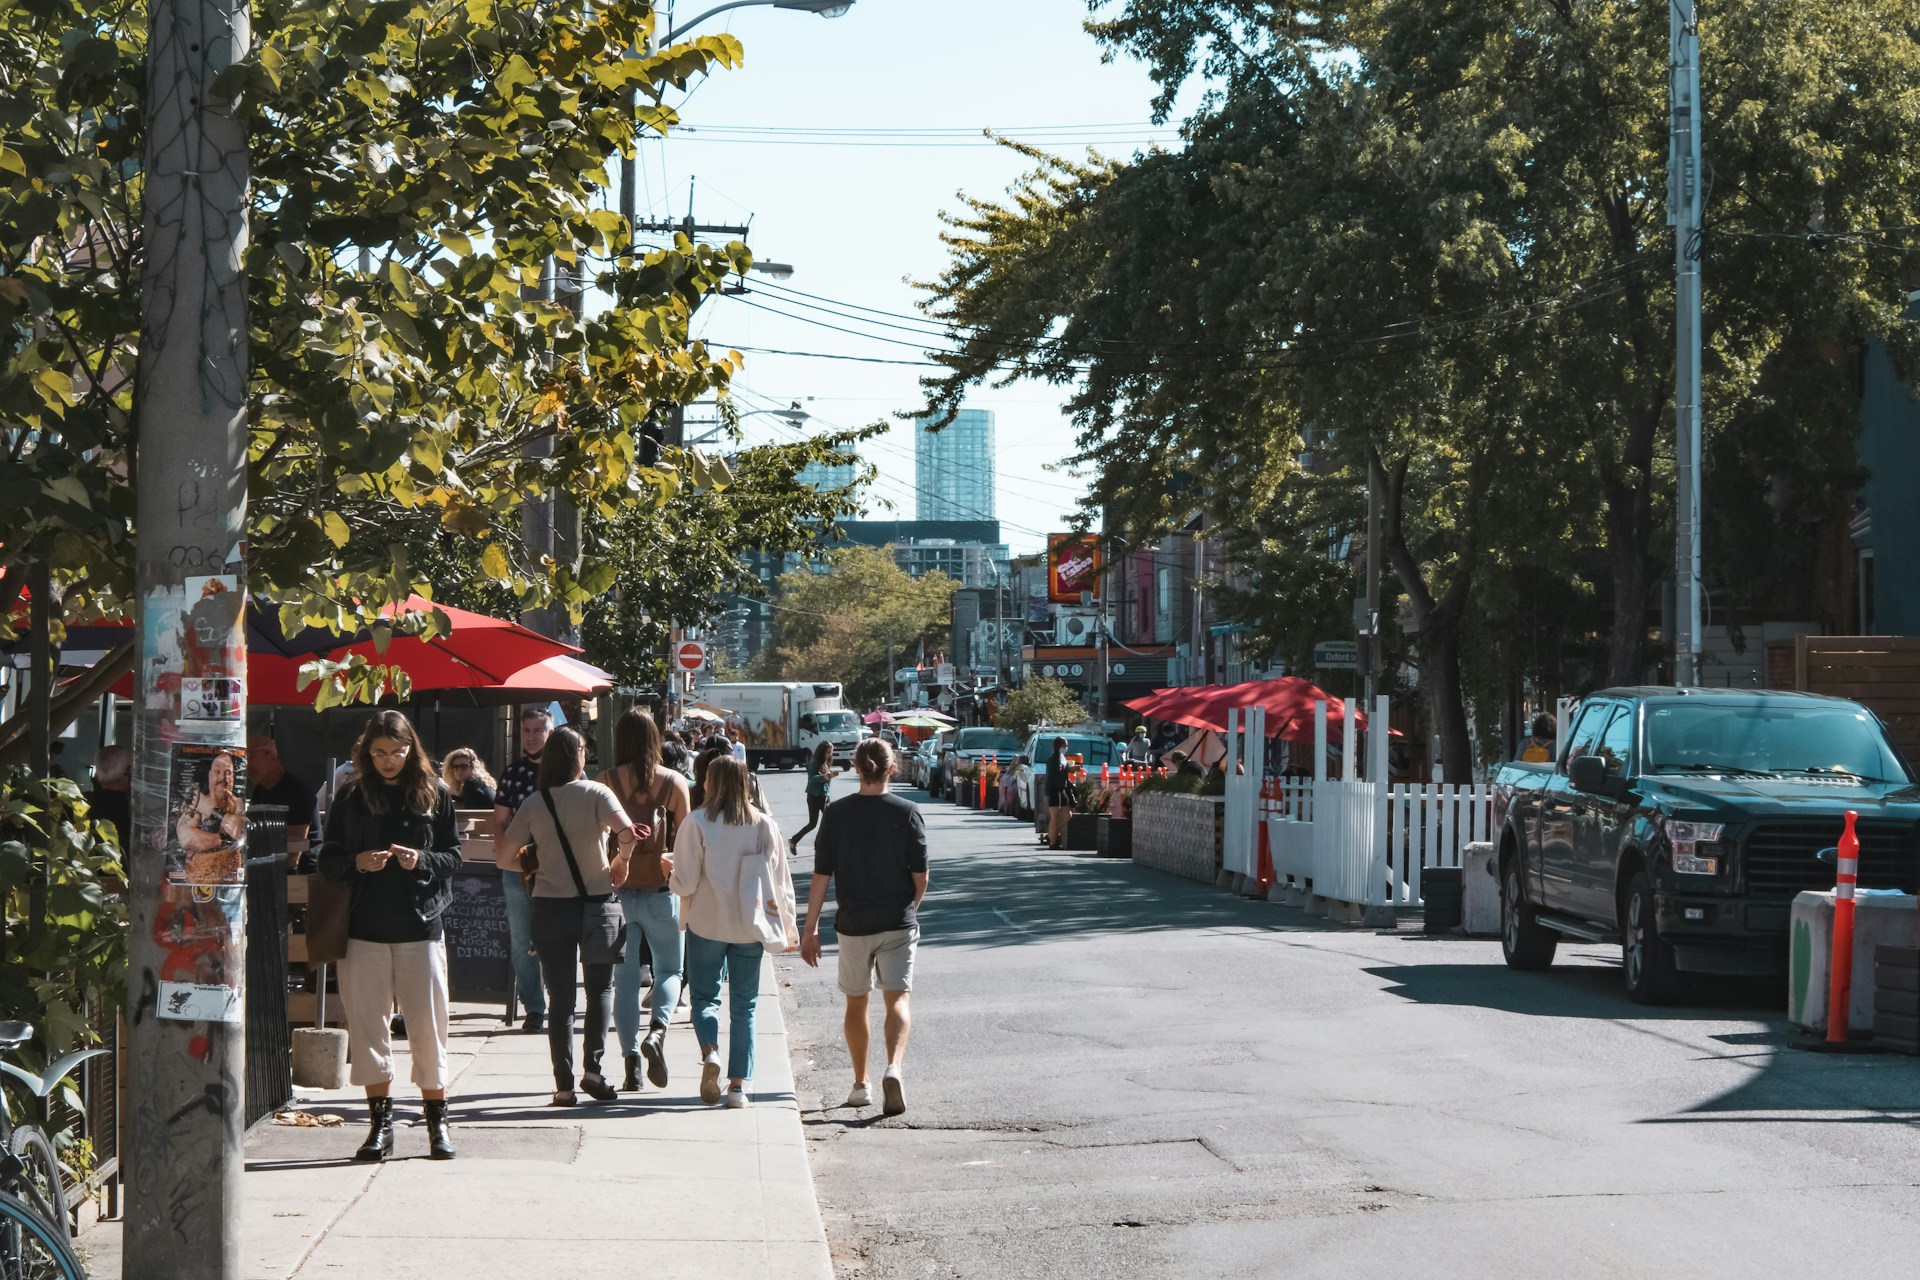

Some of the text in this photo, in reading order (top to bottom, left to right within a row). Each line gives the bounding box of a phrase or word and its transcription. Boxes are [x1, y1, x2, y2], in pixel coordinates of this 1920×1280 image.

[1325, 652, 1349, 661] Oxford
[453, 892, 488, 904] ROOF
[443, 906, 507, 918] VACCINATIO
[444, 917, 508, 932] REQUIRED
[462, 929, 488, 939] FOR
[449, 935, 501, 948] INDOOR
[457, 947, 507, 959] DINING
